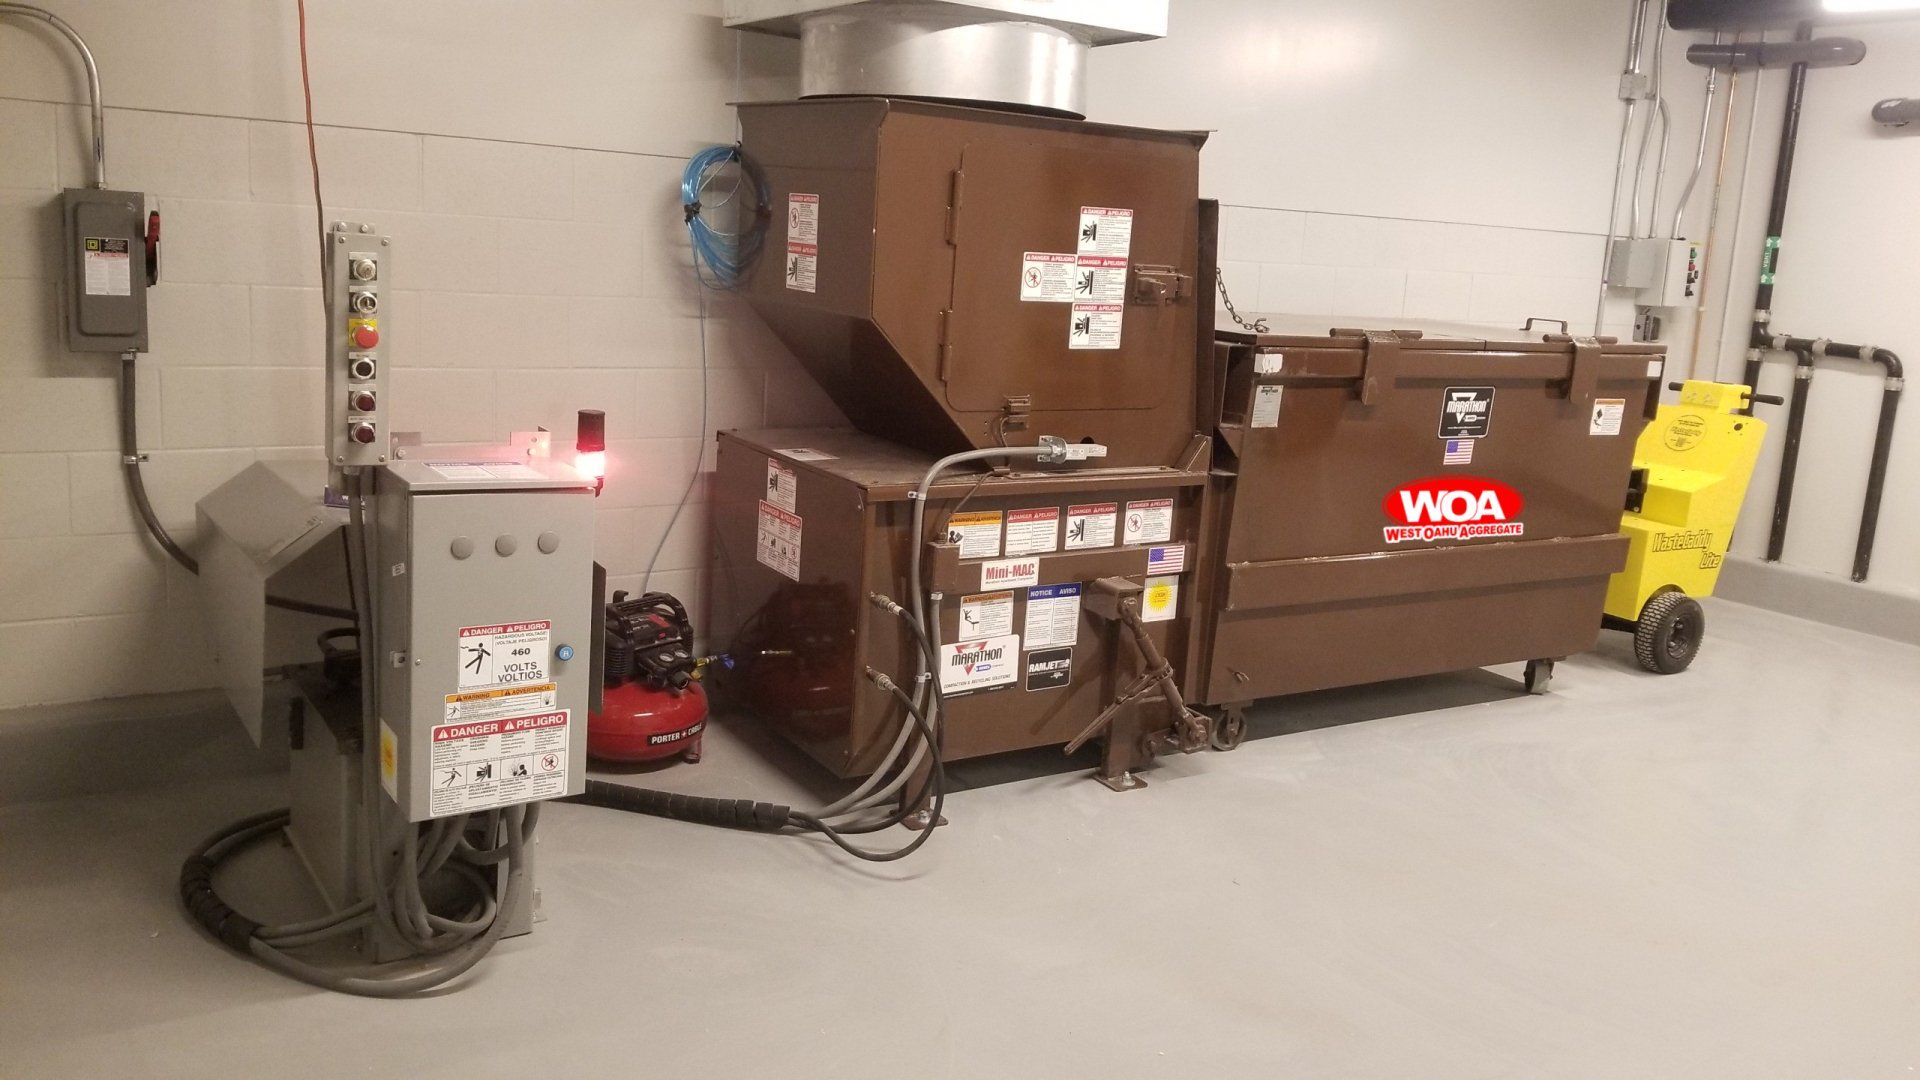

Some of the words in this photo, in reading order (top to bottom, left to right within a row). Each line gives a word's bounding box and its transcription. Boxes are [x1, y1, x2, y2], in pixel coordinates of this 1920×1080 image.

[1446, 400, 1487, 413] MARATHON
[986, 563, 1035, 580] Mini-MAC
[1030, 589, 1053, 597] NOTICE
[1058, 587, 1077, 595] AVISO
[471, 627, 503, 636] DANGER
[514, 622, 547, 632] PELIGRO
[511, 647, 531, 656] 460
[952, 648, 1003, 667] MARATHON
[503, 661, 538, 673] VOLTS
[1029, 660, 1059, 673] RAMJET
[498, 670, 543, 682] VOLTIOS
[511, 685, 551, 695] ADVERTENCIA
[450, 724, 499, 738] DANGER
[516, 714, 564, 729] PELIGRO
[651, 732, 680, 744] PORTER
